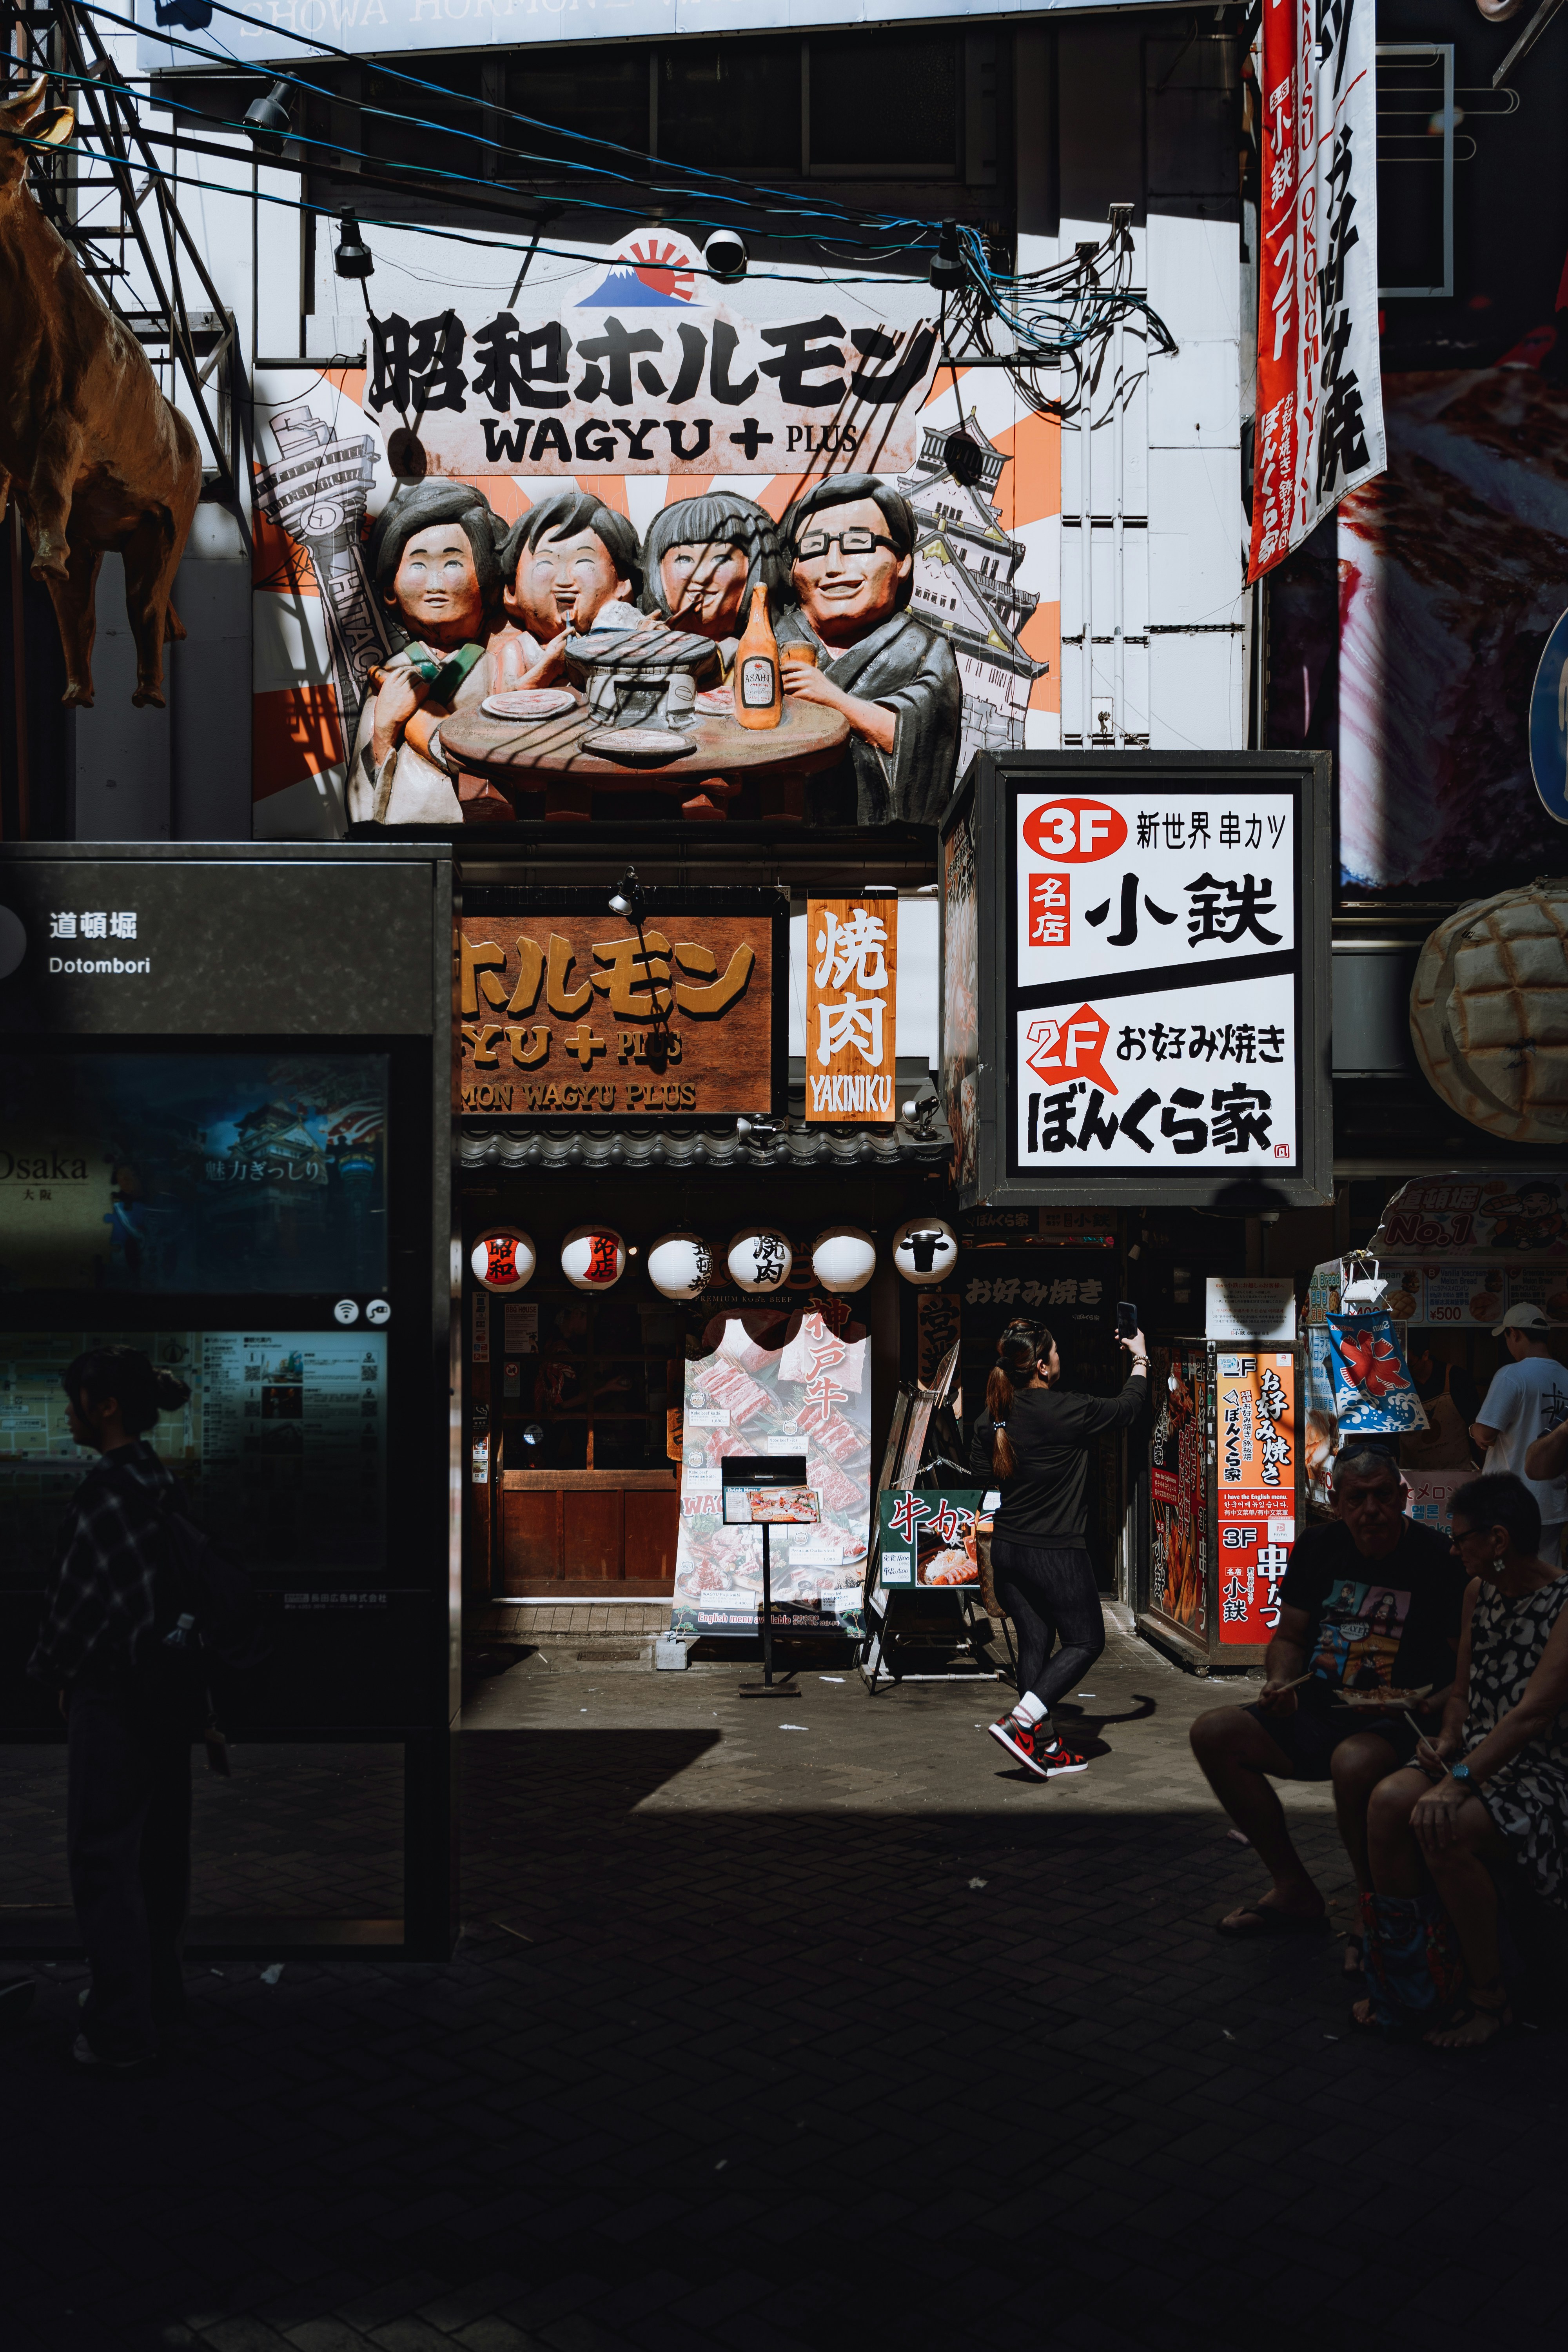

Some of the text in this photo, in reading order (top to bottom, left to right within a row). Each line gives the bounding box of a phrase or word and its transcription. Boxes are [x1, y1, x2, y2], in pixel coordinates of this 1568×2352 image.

[1272, 234, 1294, 361] 2F
[367, 308, 941, 414] 昭和ホルモン
[479, 419, 713, 463] WAGYU
[786, 424, 858, 454] PLUS
[1258, 398, 1284, 564] ぼんくら家
[746, 674, 769, 683] ASAHI
[1039, 808, 1112, 854] 3F
[1136, 810, 1286, 849] 新世界 串カツ
[49, 912, 138, 940] 道頓堀
[1033, 878, 1068, 942] 名店
[49, 957, 151, 974] Dotombori
[814, 908, 888, 1068] 焼肉
[617, 1031, 682, 1058] PLUS
[1026, 1020, 1100, 1069] 2F
[1116, 1022, 1285, 1063] お好み焼き
[523, 1083, 696, 1110] WAGYU PLUS
[809, 1074, 892, 1112] YAKINIKU
[1027, 1082, 1272, 1154] ぼんくら家
[206, 1161, 319, 1181] 魅力ぎっしり
[23, 1189, 51, 1201] 大阪
[1396, 1187, 1481, 1211] 道頓堀
[976, 1212, 1029, 1227] ぼんくら家
[1385, 1214, 1472, 1245] No.1
[490, 1238, 514, 1279] 昭和
[591, 1236, 618, 1278] 名店
[753, 1233, 786, 1284] 焼肉
[1429, 1269, 1435, 1277] B
[965, 1278, 1103, 1307] お好み焼き
[1319, 1272, 1340, 1287] Bread
[1430, 1307, 1461, 1320] ¥500
[804, 1298, 850, 1419] 神戸牛
[1196, 1357, 1205, 1381] 2F
[1197, 1385, 1206, 1499] お好み焼き
[1224, 1406, 1242, 1482] ぼんくら家
[1256, 1368, 1291, 1485] お好み焼き
[1223, 1528, 1256, 1548] 3F
[1223, 1576, 1248, 1622] 小鉄
[698, 1613, 728, 1624] English
[754, 1615, 791, 1625] avlable
